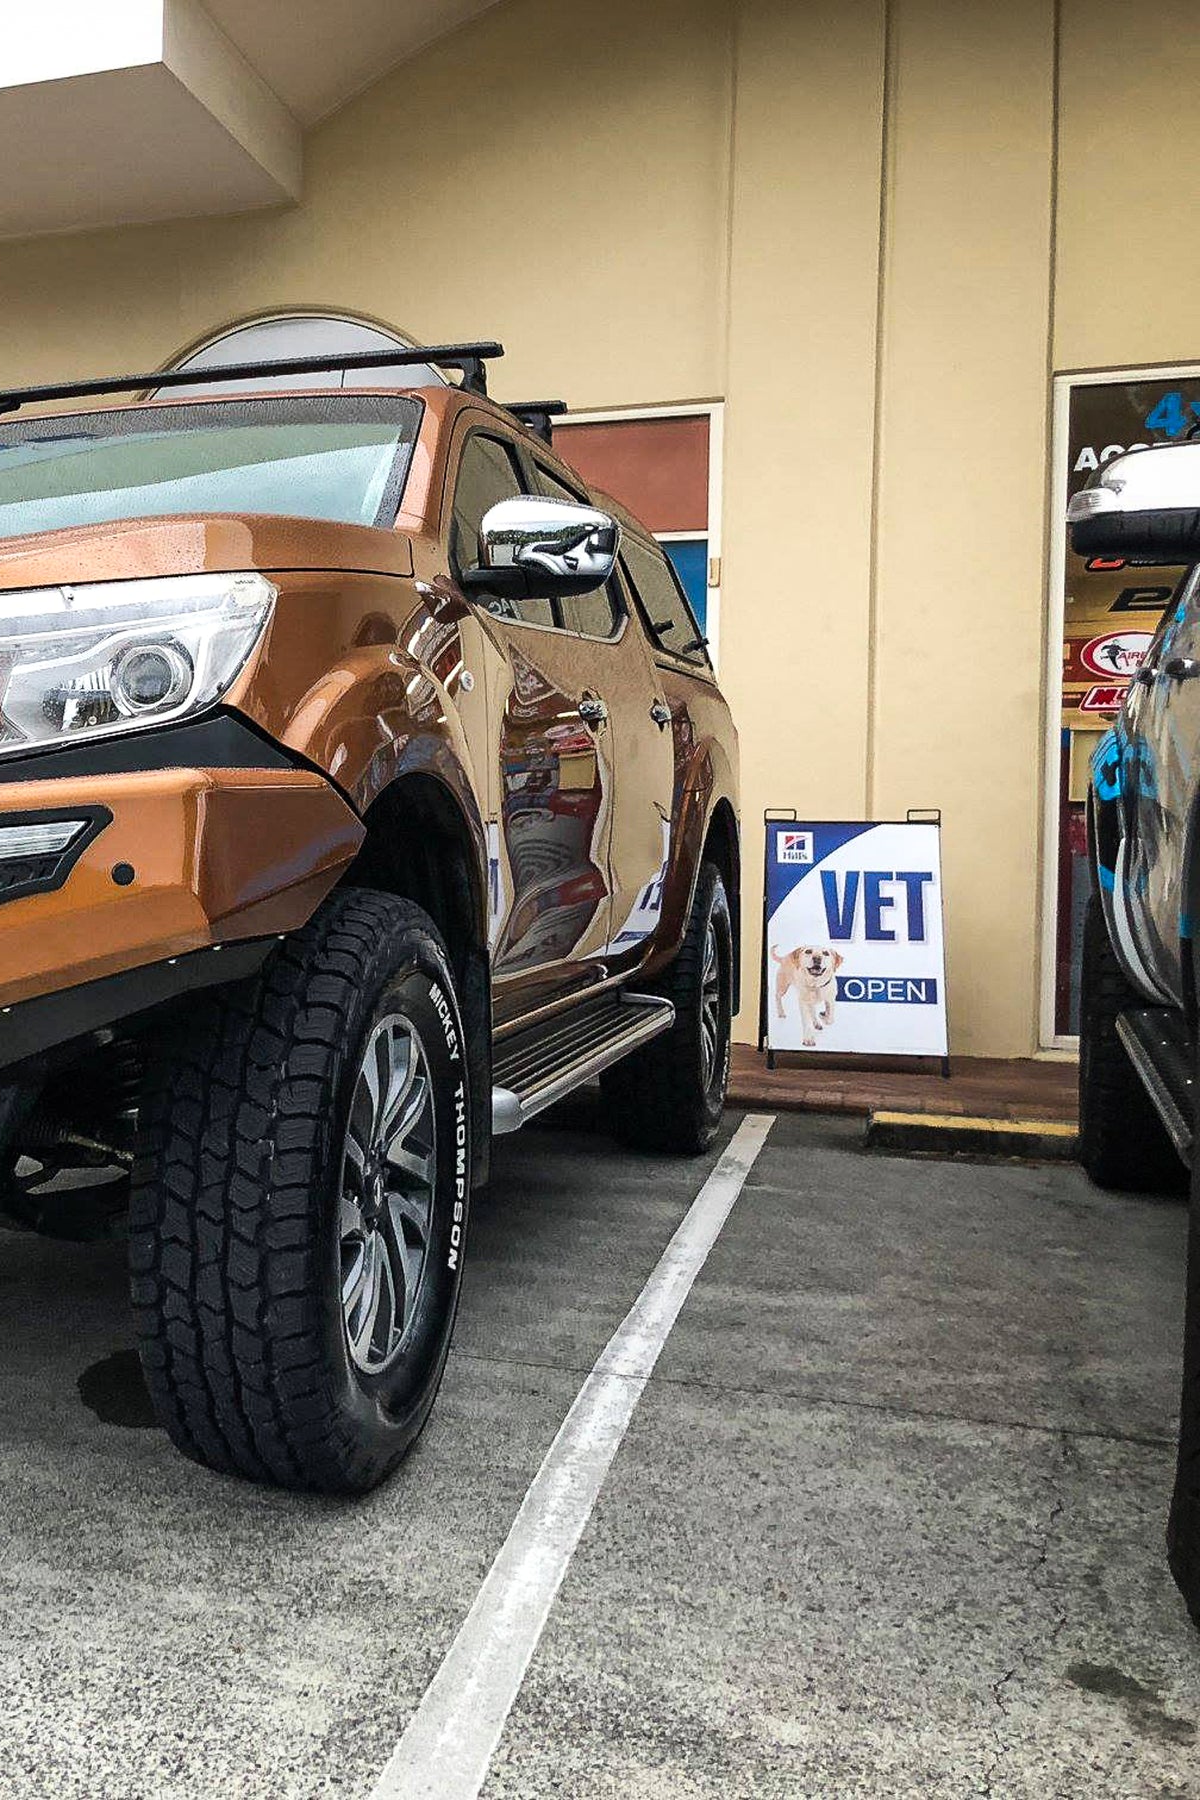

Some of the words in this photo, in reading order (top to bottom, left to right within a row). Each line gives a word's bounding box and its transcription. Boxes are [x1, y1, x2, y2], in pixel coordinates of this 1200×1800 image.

[820, 870, 933, 941] VET
[843, 979, 926, 1001] OPEN
[428, 982, 460, 1062] MICKEY
[447, 1081, 465, 1270] THOMPSON
